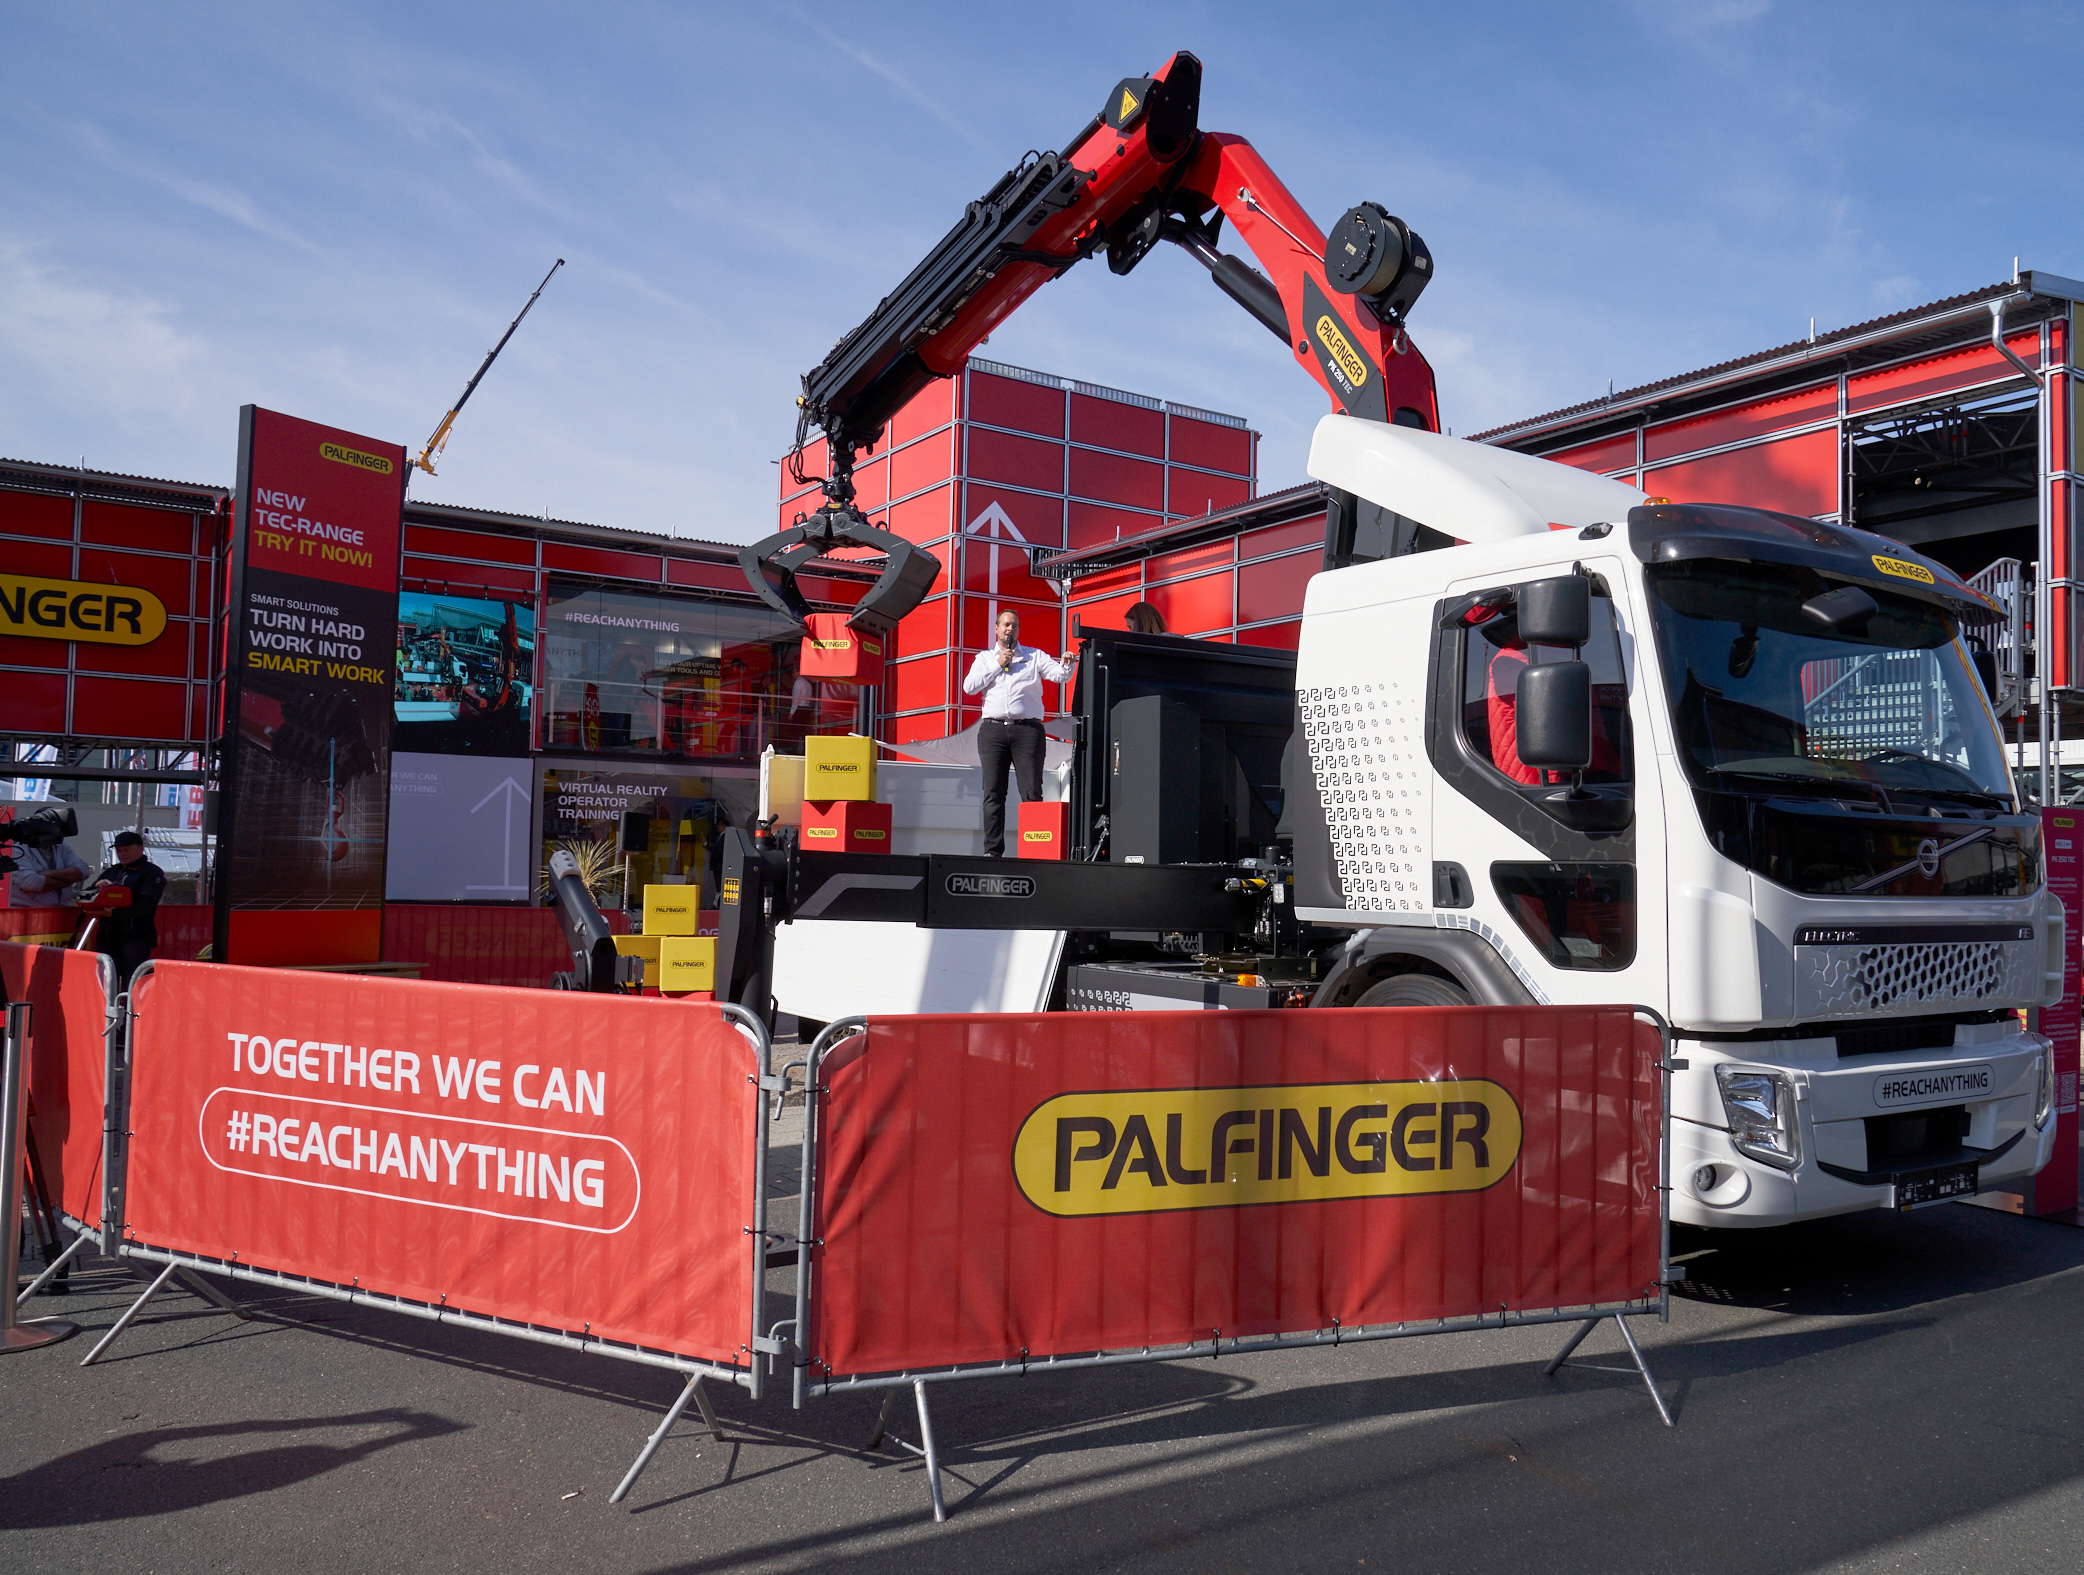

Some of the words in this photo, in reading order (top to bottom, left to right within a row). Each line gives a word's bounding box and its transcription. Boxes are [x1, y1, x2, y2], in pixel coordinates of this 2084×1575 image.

[1319, 320, 1363, 382] PALFINGER
[1328, 360, 1337, 372] PK
[1334, 368, 1344, 382] 250
[1342, 380, 1352, 394] TEC
[324, 445, 389, 471] PALFINGER
[257, 487, 306, 512] NEW
[255, 508, 364, 546] TEC-RANGE
[254, 530, 294, 551] TRY
[299, 539, 317, 556] IT
[321, 544, 373, 568] NOW!
[1876, 558, 1932, 581] PALFINGER
[251, 593, 285, 607] SMART
[287, 599, 339, 616] SOLUTIONS
[250, 608, 306, 632] TURN
[311, 618, 365, 641] HARD
[565, 612, 679, 632] #REACHANYTHING
[249, 629, 313, 654] WORK
[318, 640, 362, 660] INTO
[813, 640, 848, 648] PALFINGER
[248, 651, 322, 676] SMART
[326, 662, 385, 684] WORK
[418, 773, 437, 781] CAN
[819, 764, 858, 772] PALFINGER
[558, 782, 614, 795] VIRTUAL
[616, 784, 668, 797] REALITY
[558, 795, 628, 808] OPERATOR
[557, 808, 620, 821] TRAINING
[809, 829, 836, 837] PALFINGER
[856, 830, 884, 838] PALFINGER
[952, 877, 1030, 894] PALFINGER
[1804, 930, 1860, 942] ELECTRIC
[2018, 927, 2032, 939] FE
[228, 1032, 420, 1095] TOGETHER
[432, 1054, 501, 1105] WE
[513, 1064, 605, 1116] CAN
[1882, 1072, 1988, 1099] #REACHANYTHING
[227, 1109, 604, 1208] #REACHANYTHING
[1054, 1101, 1491, 1193] PALFINGER
